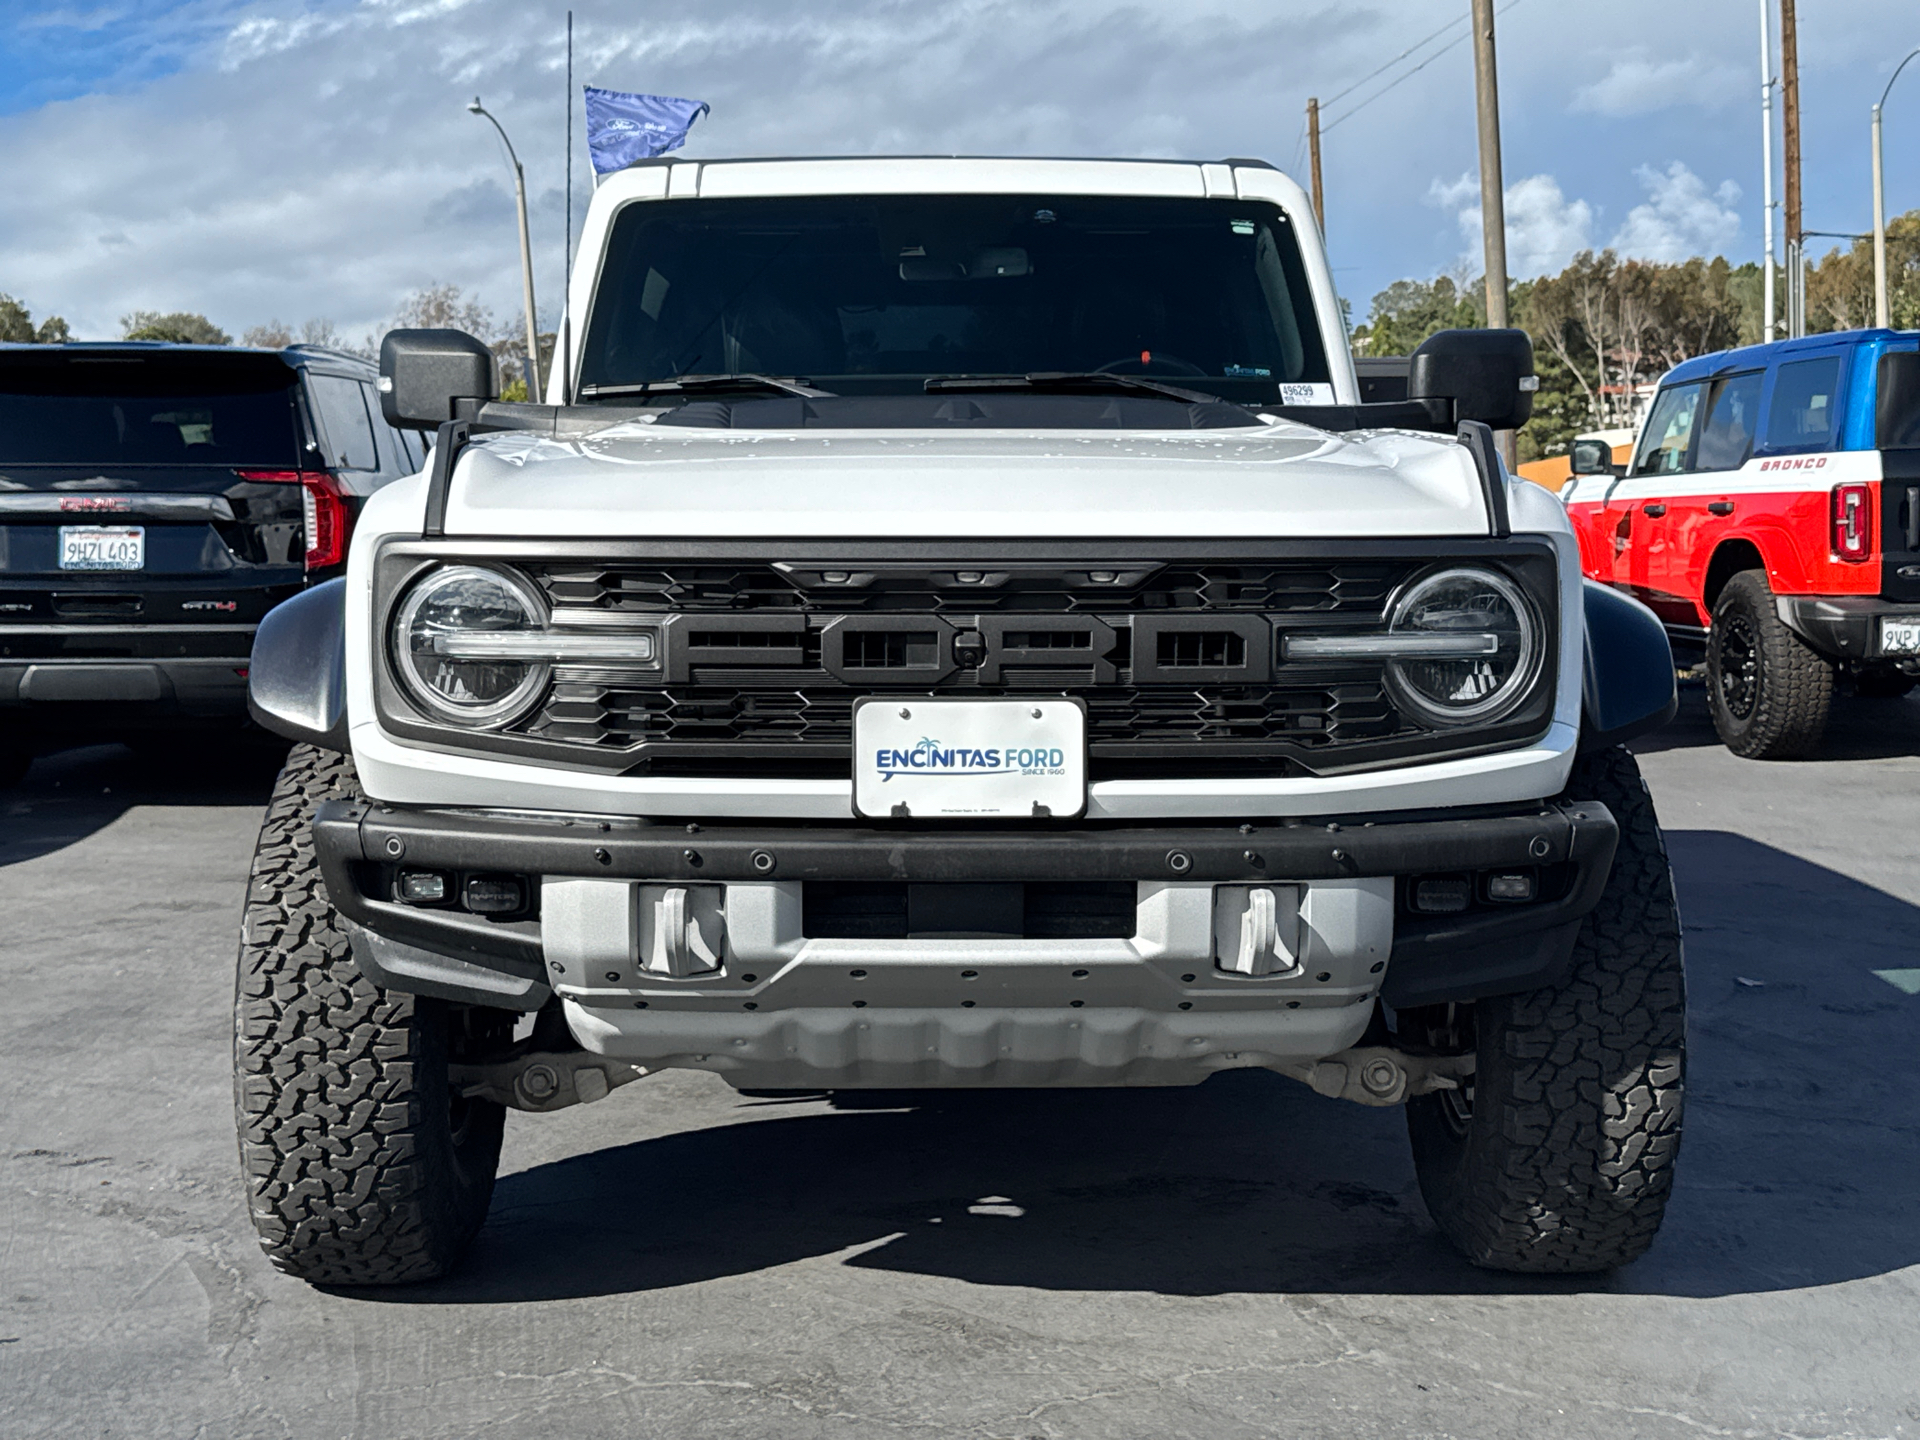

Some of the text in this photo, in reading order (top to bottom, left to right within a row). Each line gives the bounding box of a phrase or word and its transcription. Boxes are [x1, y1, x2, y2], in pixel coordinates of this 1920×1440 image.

[1283, 385, 1314, 396] 496299
[1760, 457, 1827, 472] BRONCO
[662, 613, 1273, 685] FORD
[1886, 630, 1920, 651] 9VP
[876, 748, 1064, 768] ENCINITAS FORD
[1021, 768, 1066, 776] SINCE 1960
